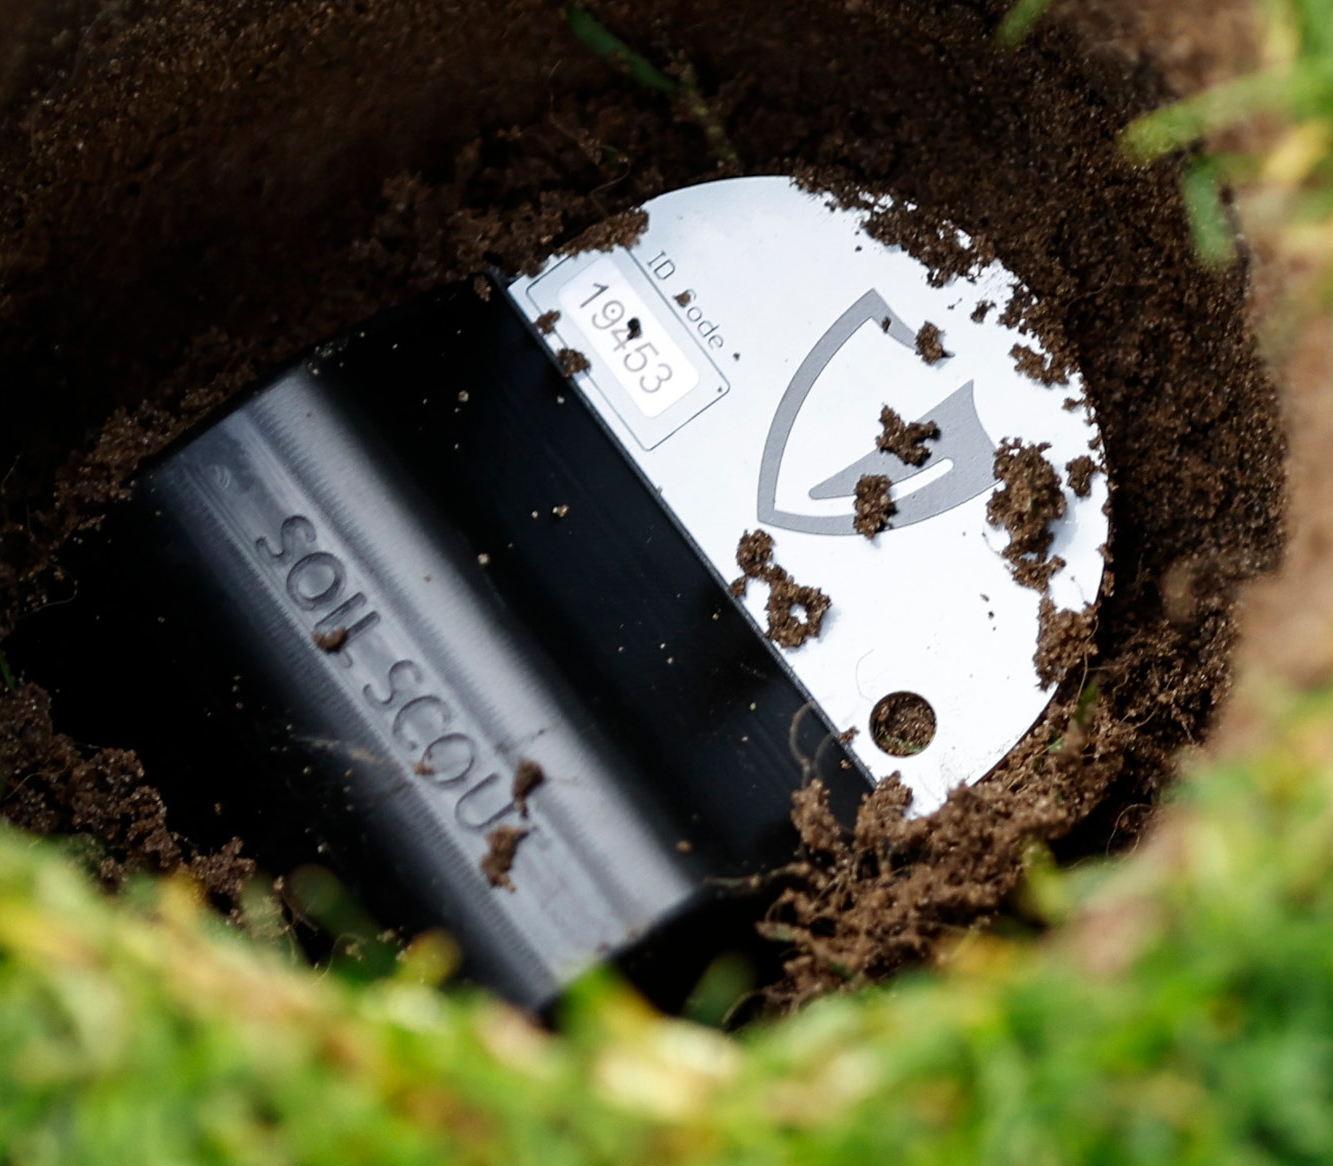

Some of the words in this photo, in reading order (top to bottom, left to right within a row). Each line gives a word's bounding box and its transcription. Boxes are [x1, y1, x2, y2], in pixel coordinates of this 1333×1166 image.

[646, 250, 676, 281] ID
[579, 281, 674, 395] 19453
[254, 514, 381, 668] SOIL
[362, 658, 543, 862] SCOU
